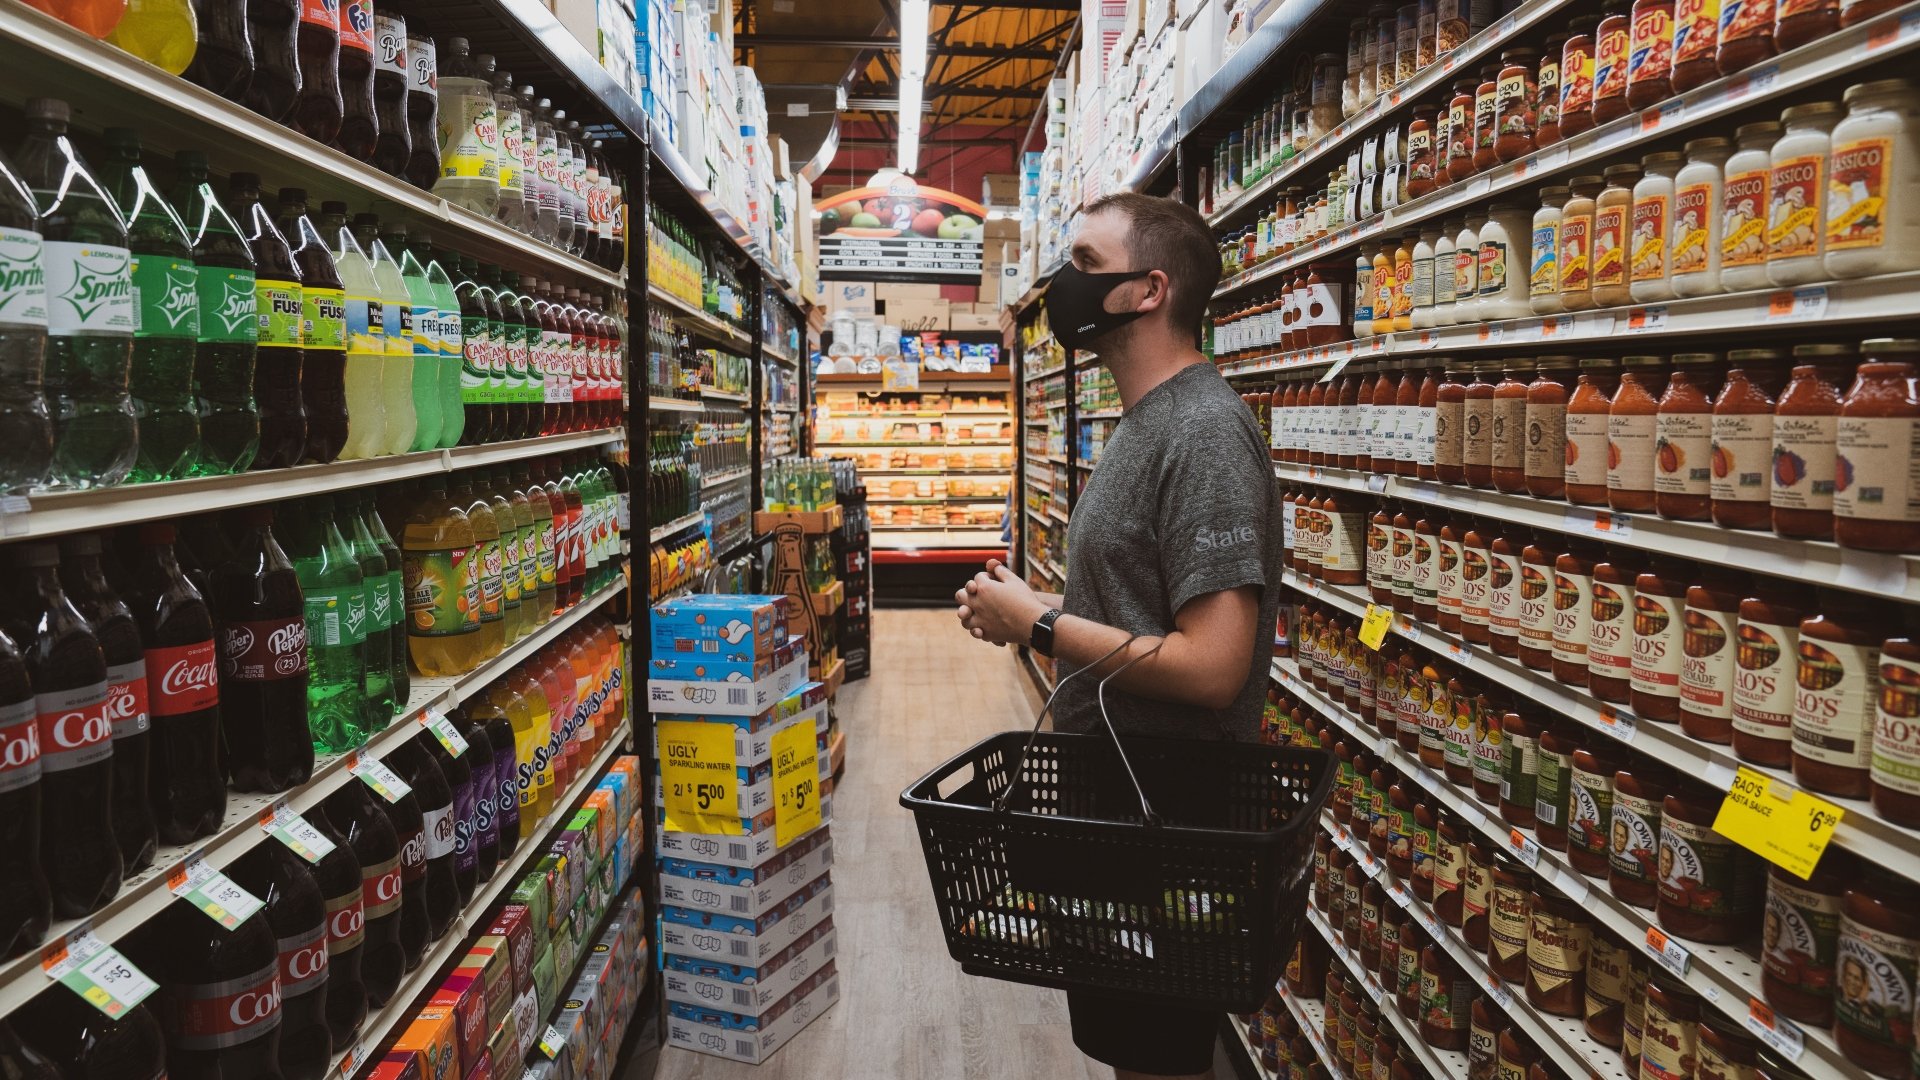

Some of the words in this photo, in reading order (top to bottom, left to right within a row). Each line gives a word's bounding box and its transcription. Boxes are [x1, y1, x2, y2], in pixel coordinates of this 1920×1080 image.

[891, 202, 912, 231] 2
[668, 744, 698, 760] UGLY
[776, 751, 796, 769] UGLY
[669, 758, 705, 771] SPARKLING
[705, 761, 732, 772] WATER
[777, 760, 801, 779] SPARKLING
[799, 754, 816, 771] WATER
[673, 783, 684, 798] 2/
[687, 783, 693, 794] $
[781, 792, 789, 808] 2/
[789, 787, 795, 800] $
[1731, 775, 1764, 799] RAO'S
[1809, 807, 1815, 818] $
[1726, 789, 1750, 808] PASTA
[1749, 800, 1774, 819] SAUCE
